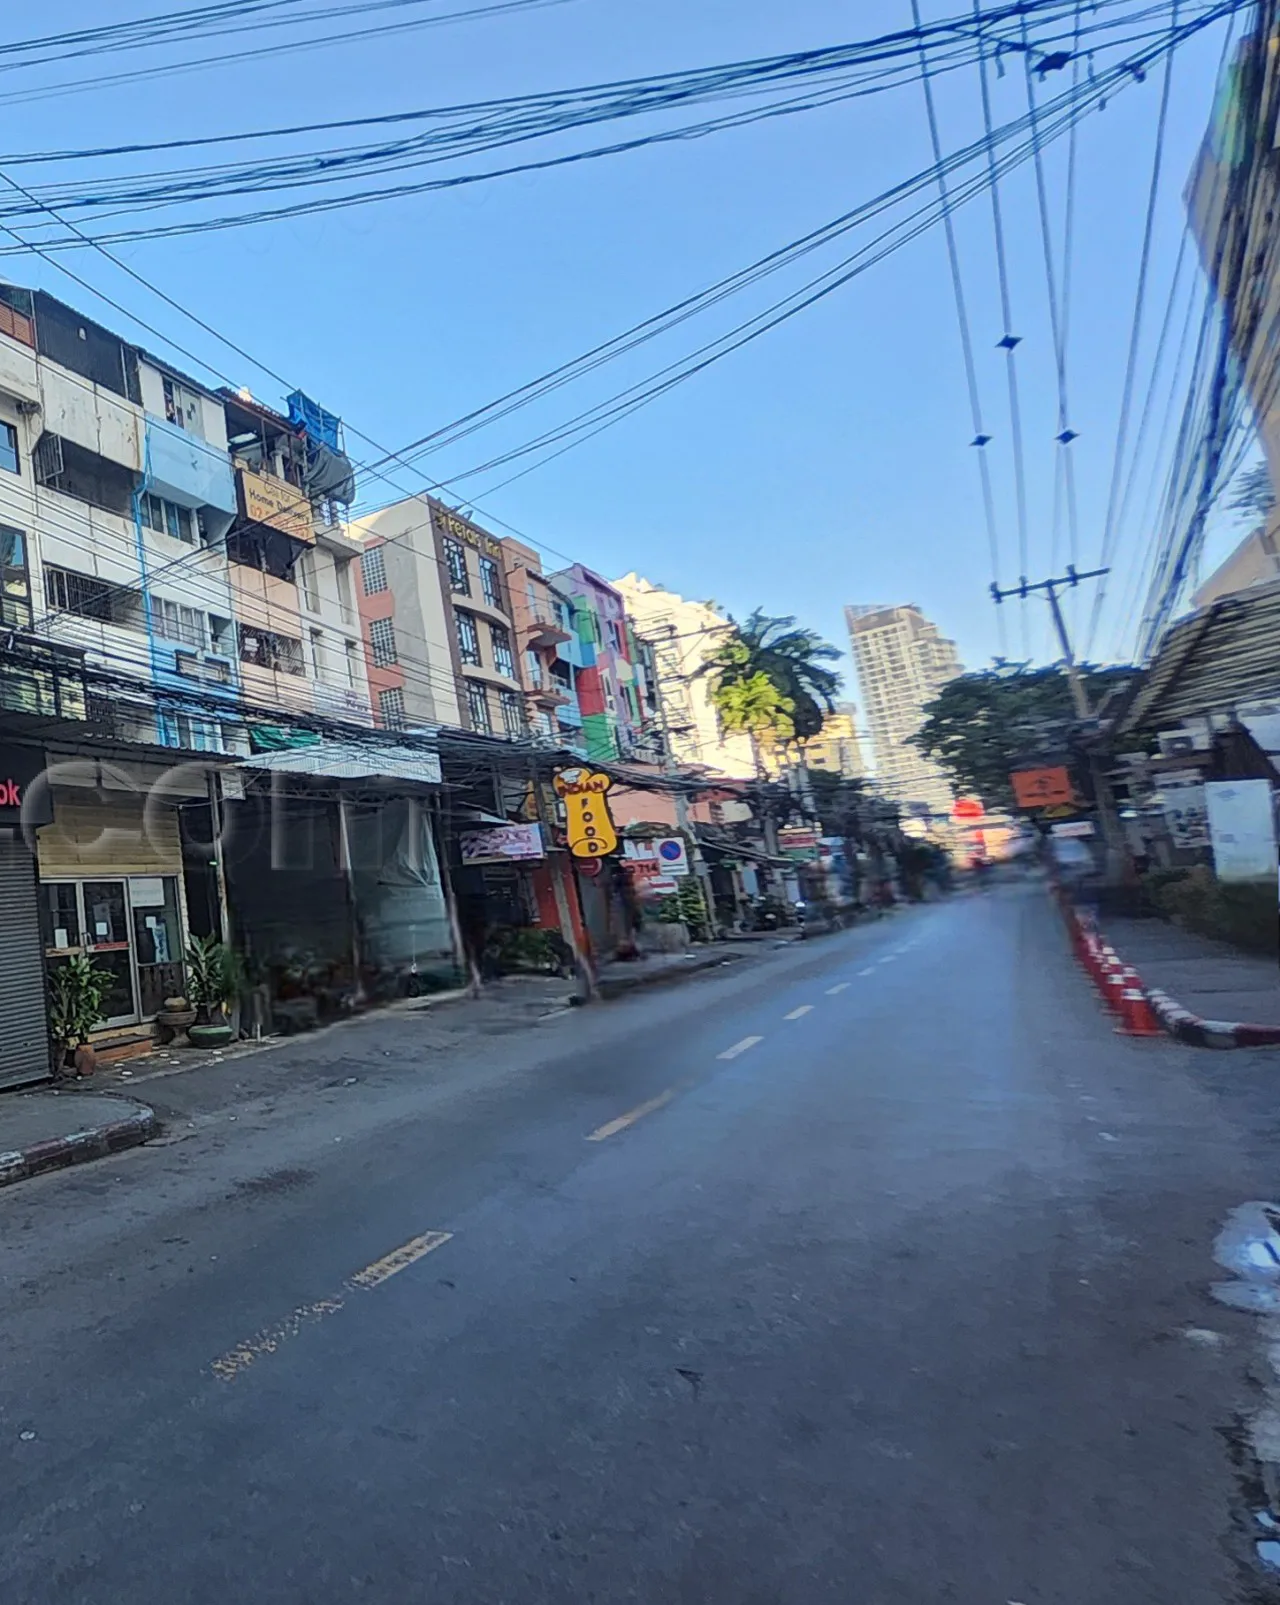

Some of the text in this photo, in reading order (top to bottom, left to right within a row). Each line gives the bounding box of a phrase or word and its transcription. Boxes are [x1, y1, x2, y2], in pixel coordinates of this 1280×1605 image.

[249, 488, 274, 508] Home
[557, 779, 604, 796] INDIAN
[581, 797, 599, 854] FOOD
